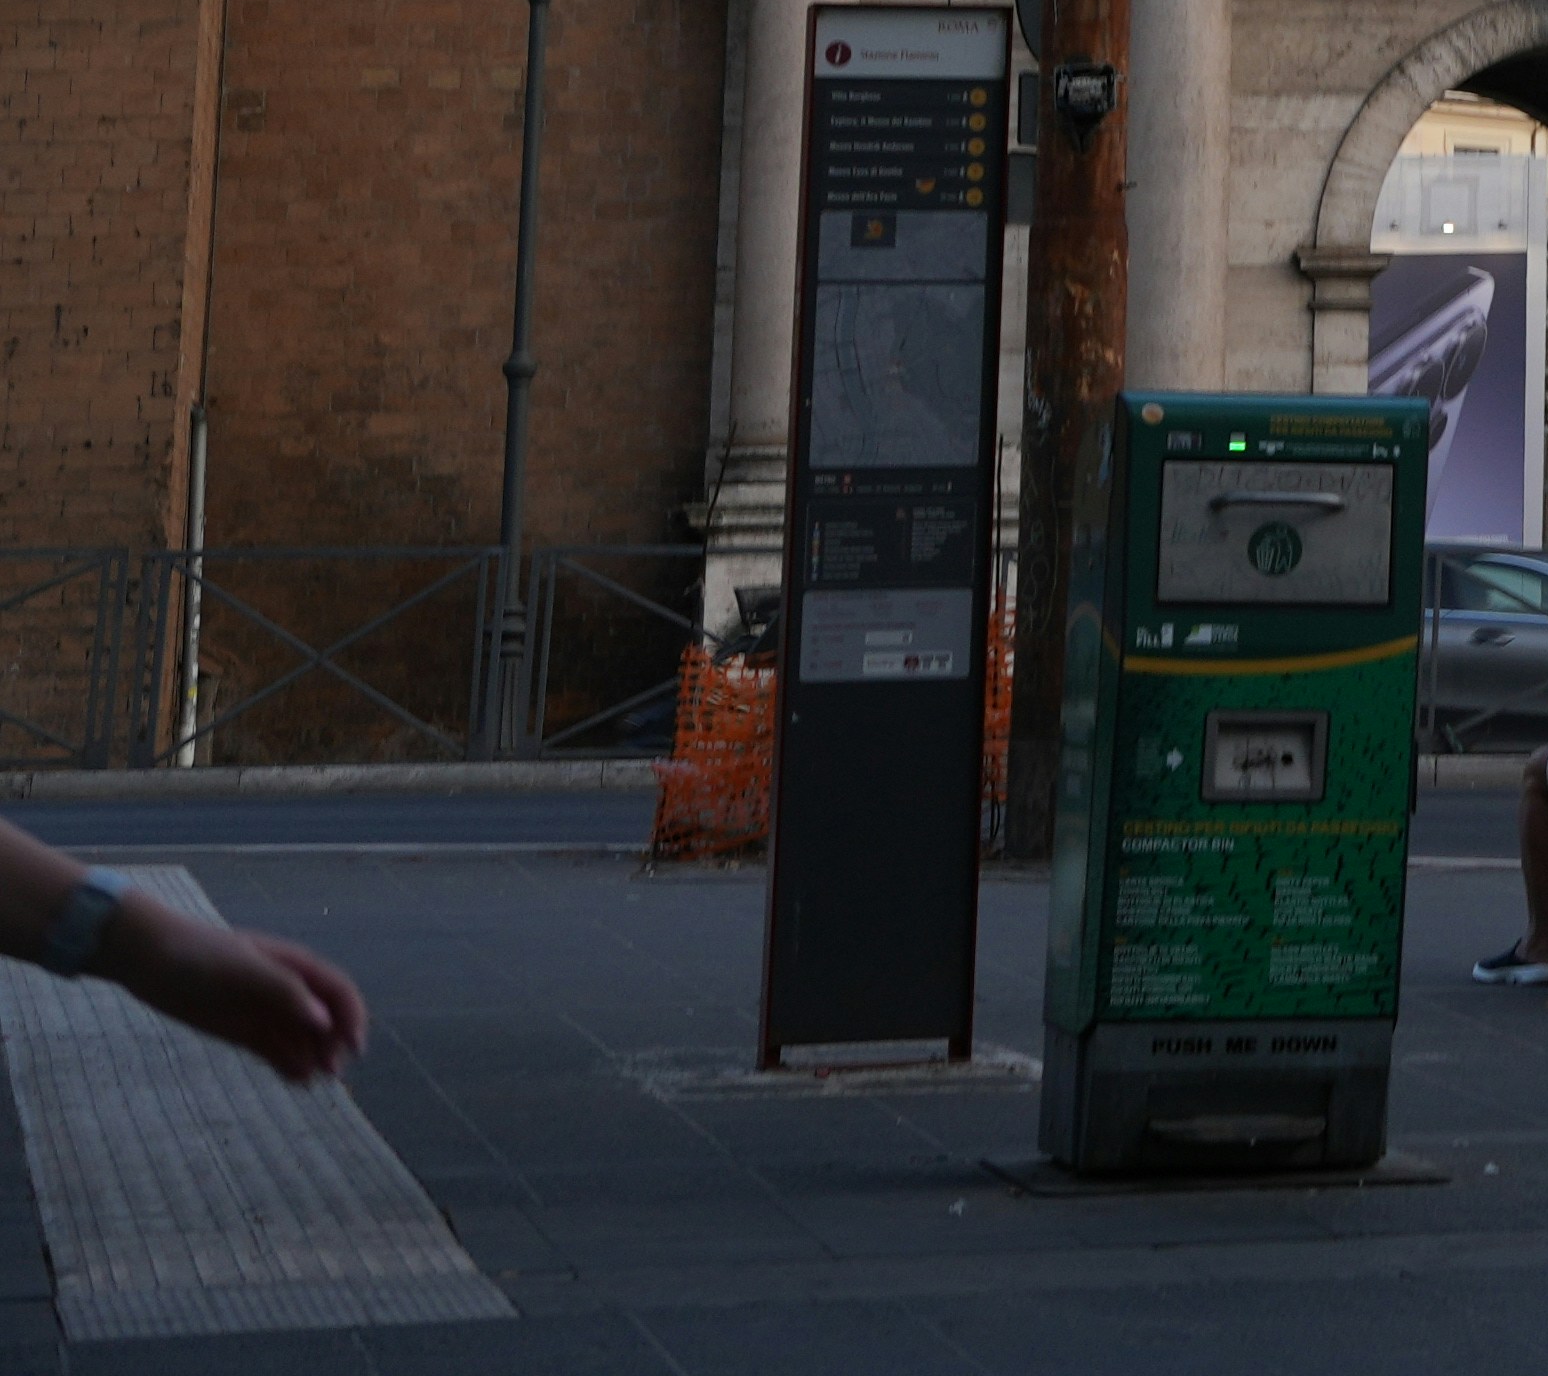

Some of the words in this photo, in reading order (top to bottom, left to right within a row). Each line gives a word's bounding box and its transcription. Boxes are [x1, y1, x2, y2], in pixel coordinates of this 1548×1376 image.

[1122, 837, 1209, 853] COMPACTOR
[1211, 837, 1235, 852] BIN
[1152, 1037, 1211, 1055] PUSH
[1226, 1036, 1256, 1054] ME
[1270, 1035, 1337, 1053] DOWN
